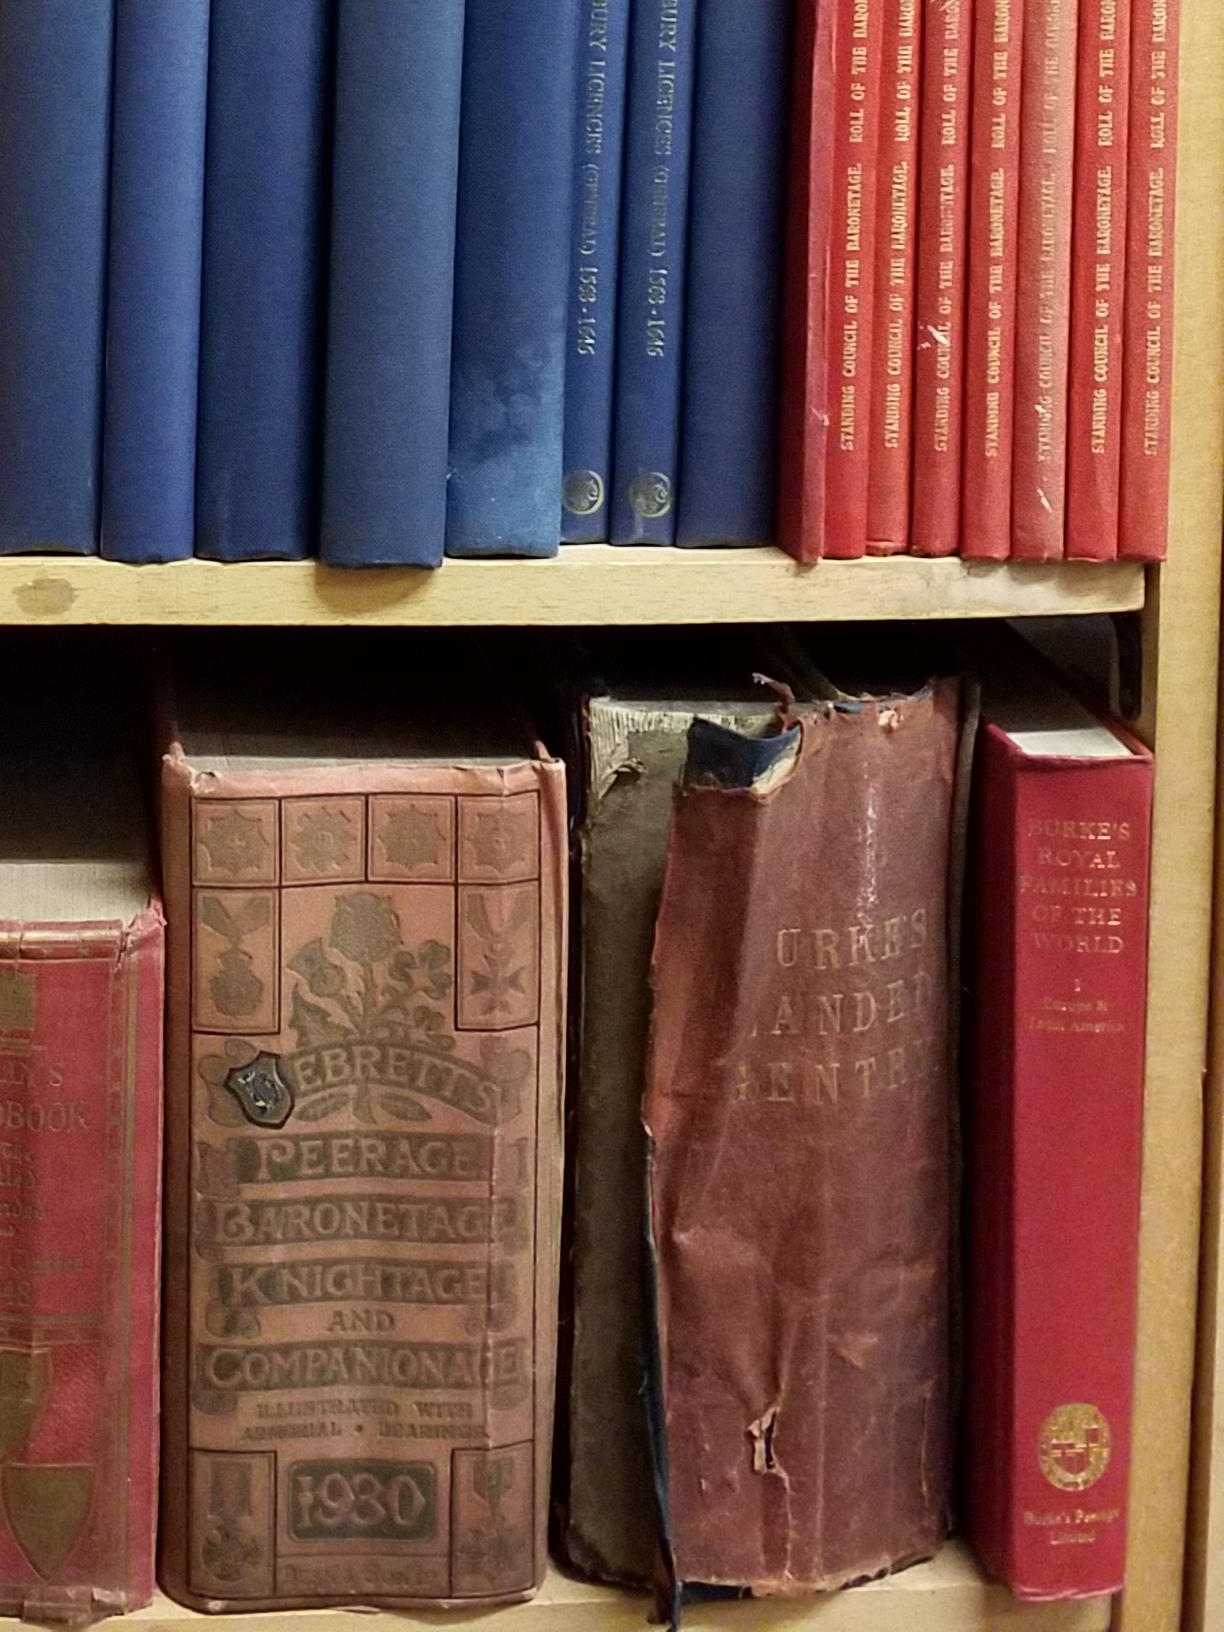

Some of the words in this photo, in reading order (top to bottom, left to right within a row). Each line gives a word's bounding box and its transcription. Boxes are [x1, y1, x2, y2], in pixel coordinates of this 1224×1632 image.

[851, 44, 867, 75] THE
[851, 81, 865, 101] OF
[849, 104, 865, 143] ROLL
[845, 259, 859, 289] THE
[844, 294, 858, 314] OF
[843, 320, 857, 379] COUNCIL
[840, 385, 856, 451] STANDING
[258, 1135, 476, 1180] PEERAGE
[328, 1309, 395, 1332] AND
[297, 1472, 426, 1528] 1930
